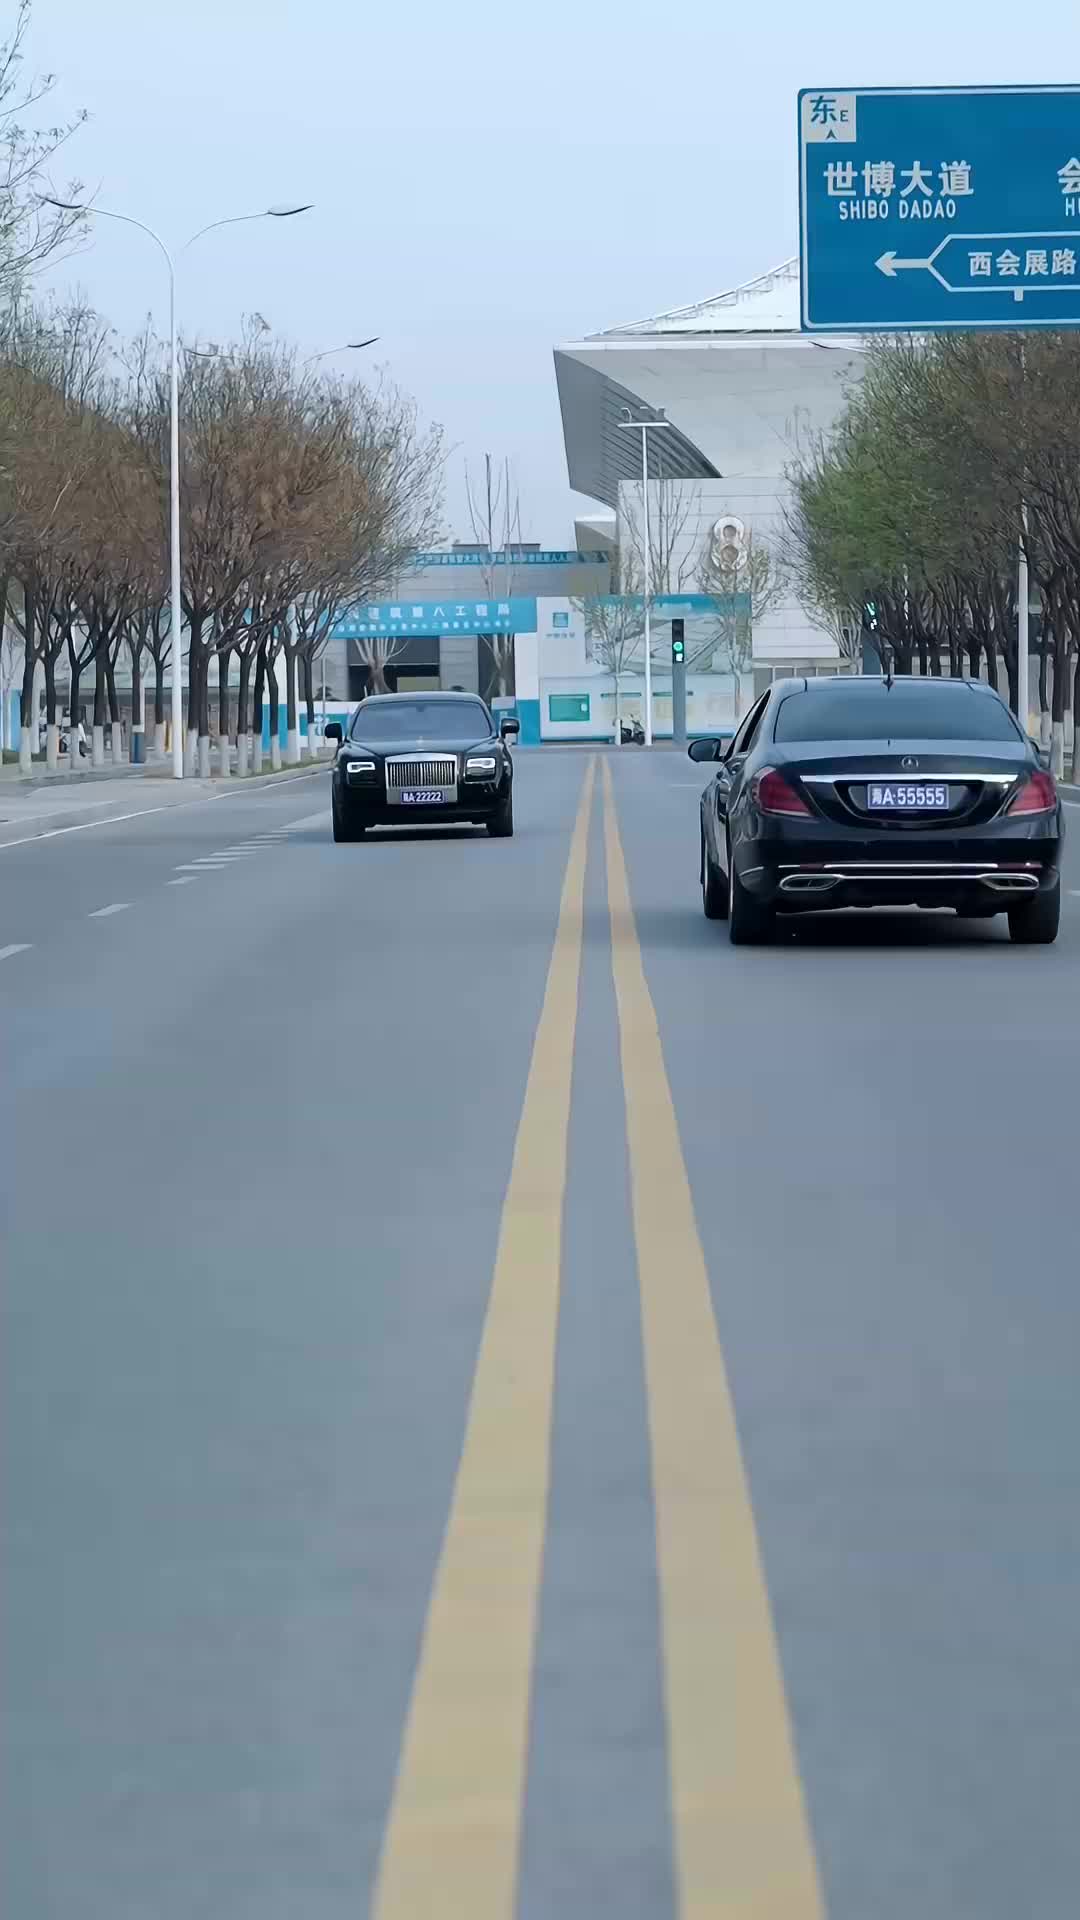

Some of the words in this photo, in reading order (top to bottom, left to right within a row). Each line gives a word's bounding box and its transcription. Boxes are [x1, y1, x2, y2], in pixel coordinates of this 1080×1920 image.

[809, 95, 838, 124] 东
[840, 109, 849, 122] E
[823, 160, 975, 198] 世博大道
[1057, 157, 1080, 194] 会
[839, 200, 889, 220] SHIBO
[899, 199, 957, 219] DADAO
[1065, 197, 1080, 217] H
[967, 248, 1077, 277] 西会展路
